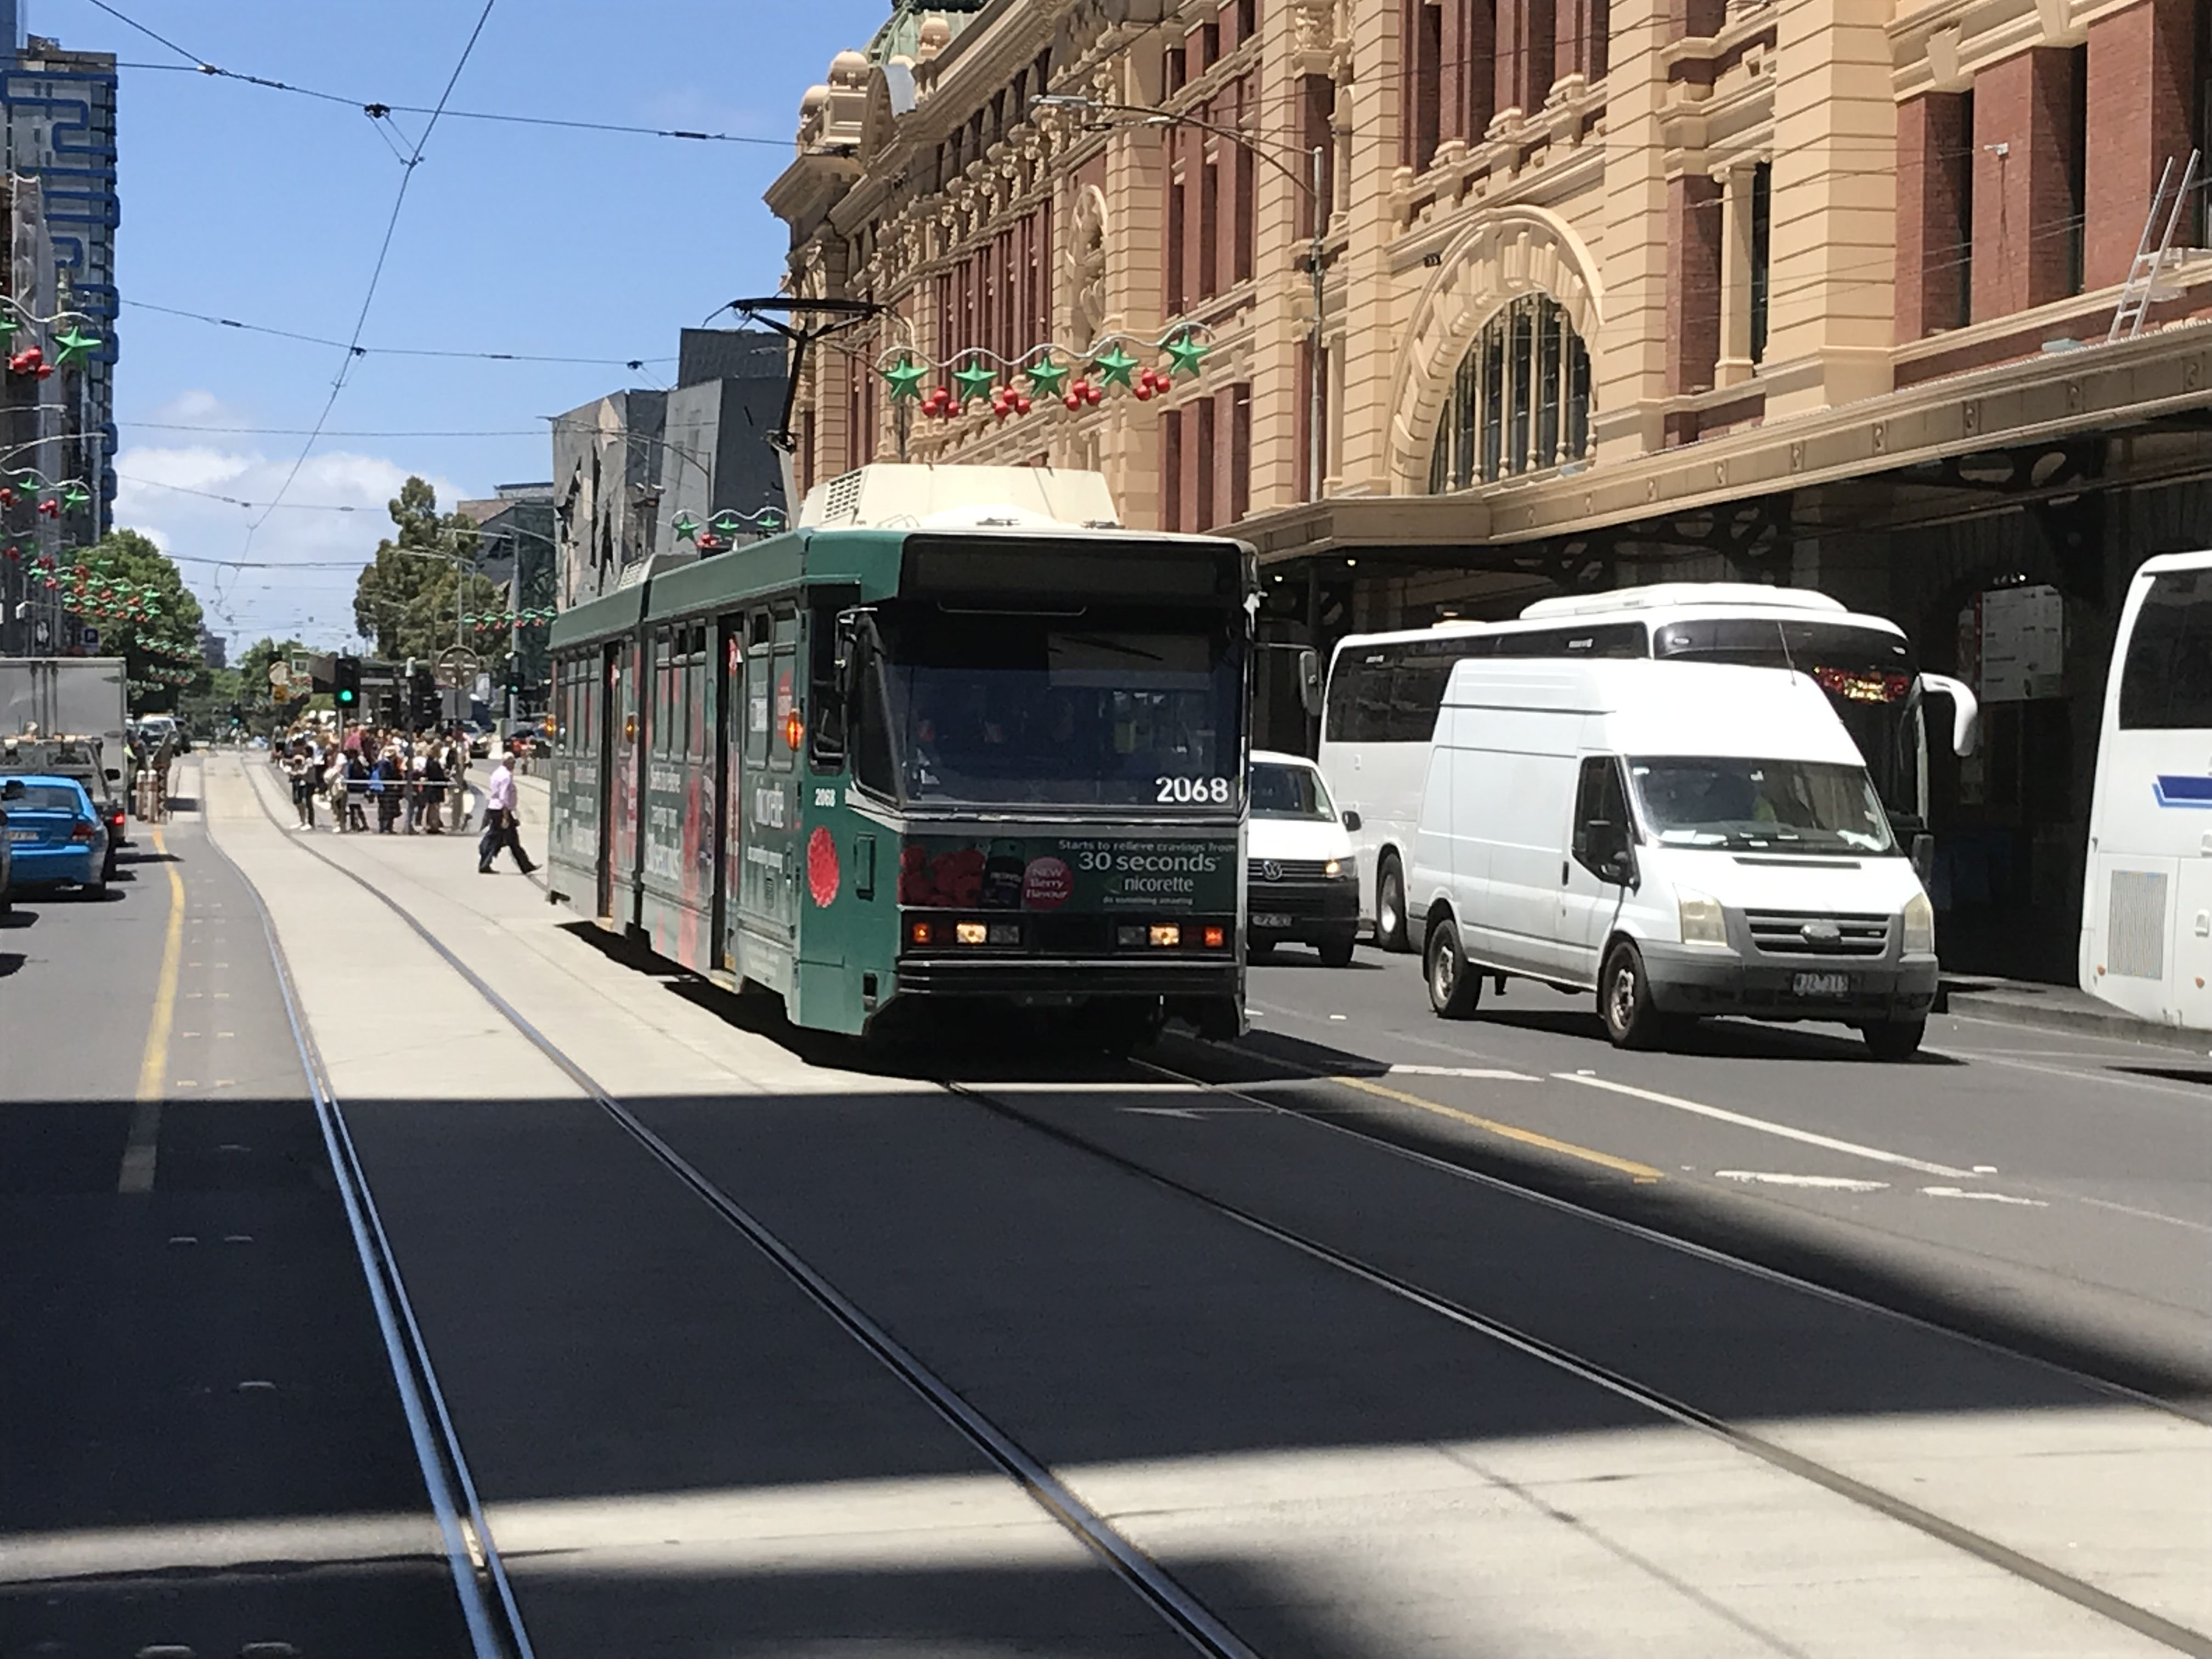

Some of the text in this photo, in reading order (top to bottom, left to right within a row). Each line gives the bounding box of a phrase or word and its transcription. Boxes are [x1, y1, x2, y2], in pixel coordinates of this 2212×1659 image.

[1156, 777, 1228, 803] 2068
[1058, 839, 1236, 854] Starts to relieve cravings from
[1079, 851, 1216, 872] 30 seconds
[1031, 868, 1063, 877] NEW
[1030, 878, 1064, 889] Berry
[1125, 875, 1194, 893] nicorette
